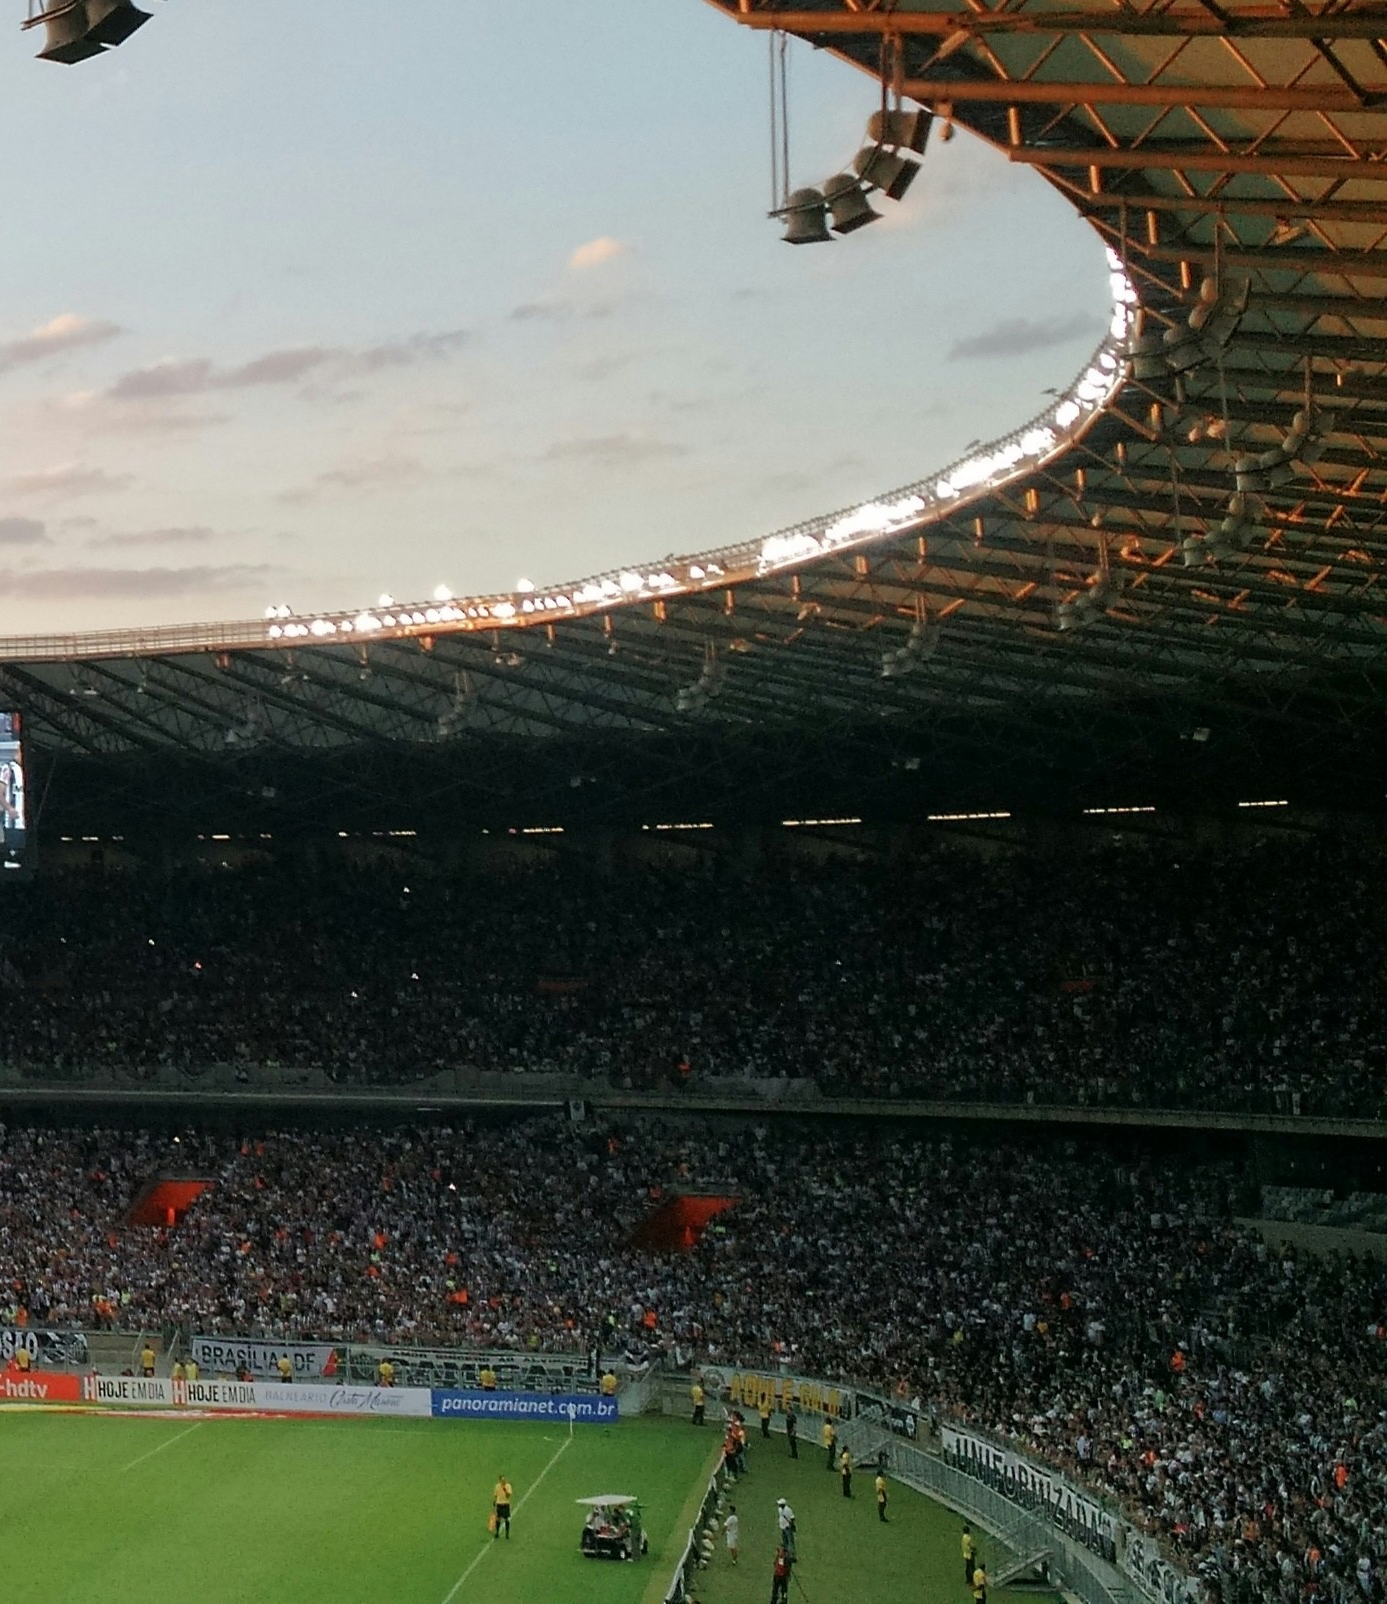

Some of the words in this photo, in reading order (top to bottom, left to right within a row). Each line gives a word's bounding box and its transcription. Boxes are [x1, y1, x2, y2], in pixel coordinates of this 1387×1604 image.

[293, 1353, 316, 1372] DF
[98, 1381, 129, 1399] HOJE
[131, 1383, 147, 1399] EM
[148, 1383, 165, 1400] DIA
[188, 1384, 220, 1402] HOJE
[222, 1386, 238, 1403] EM
[238, 1387, 256, 1404] DIA
[442, 1398, 615, 1416] panoramianet.com.br
